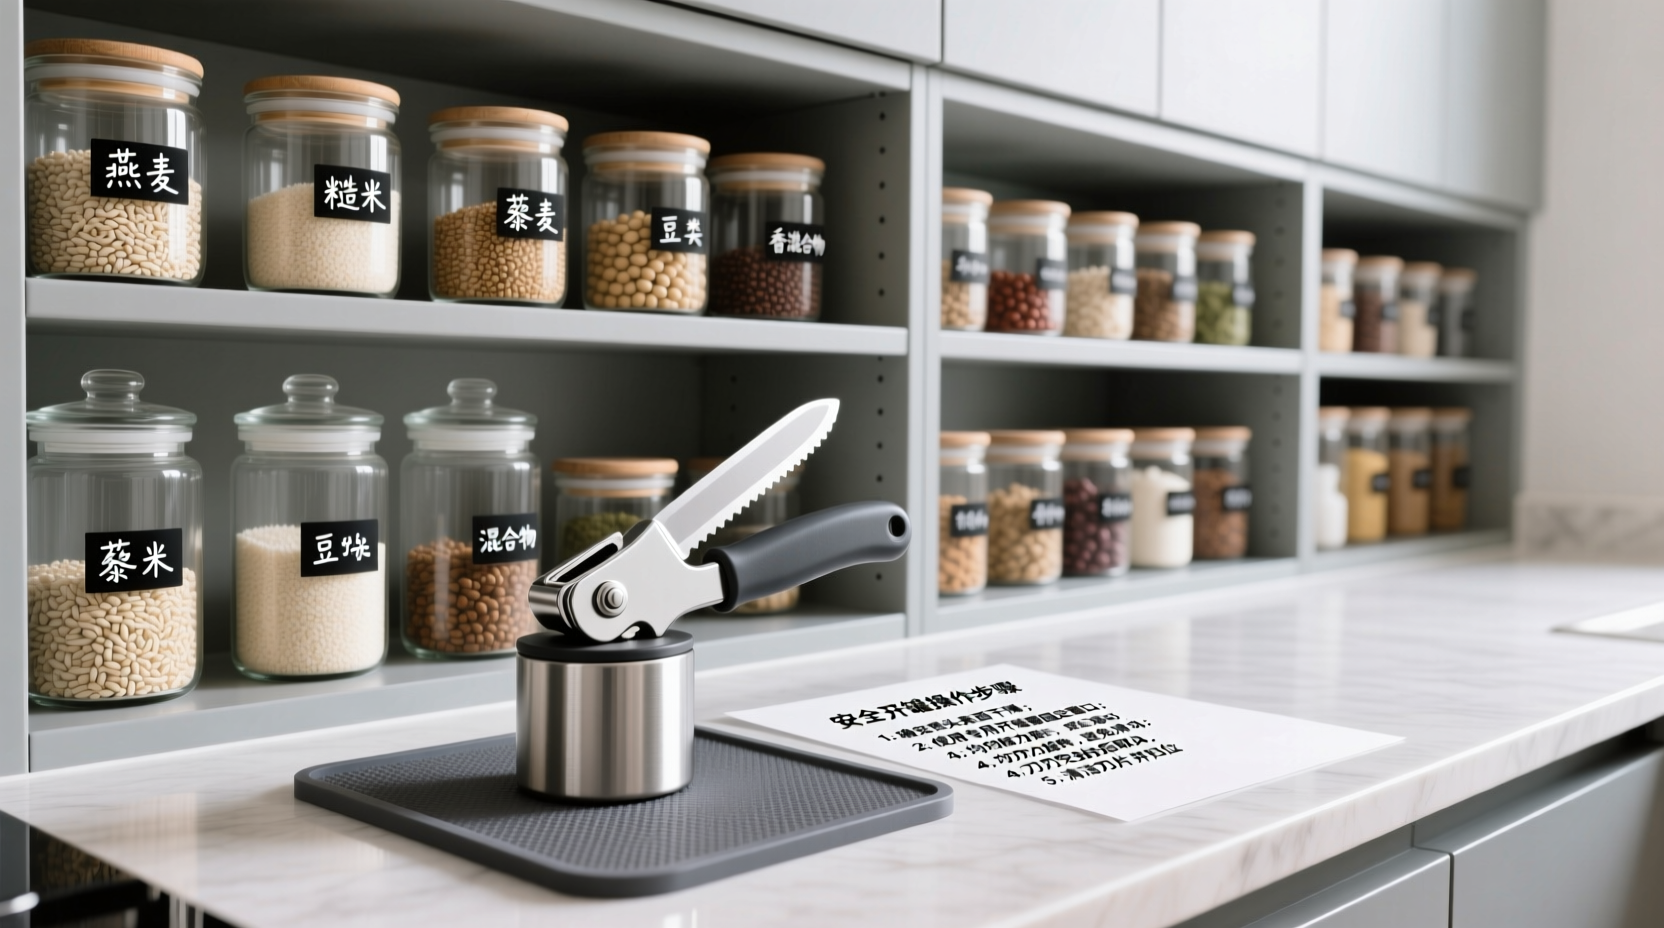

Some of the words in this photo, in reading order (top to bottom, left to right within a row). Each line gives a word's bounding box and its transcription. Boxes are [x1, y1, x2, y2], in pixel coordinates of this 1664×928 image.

[105, 147, 180, 195] 燕麦
[323, 174, 387, 213] 糙米
[478, 523, 537, 554] 混合物
